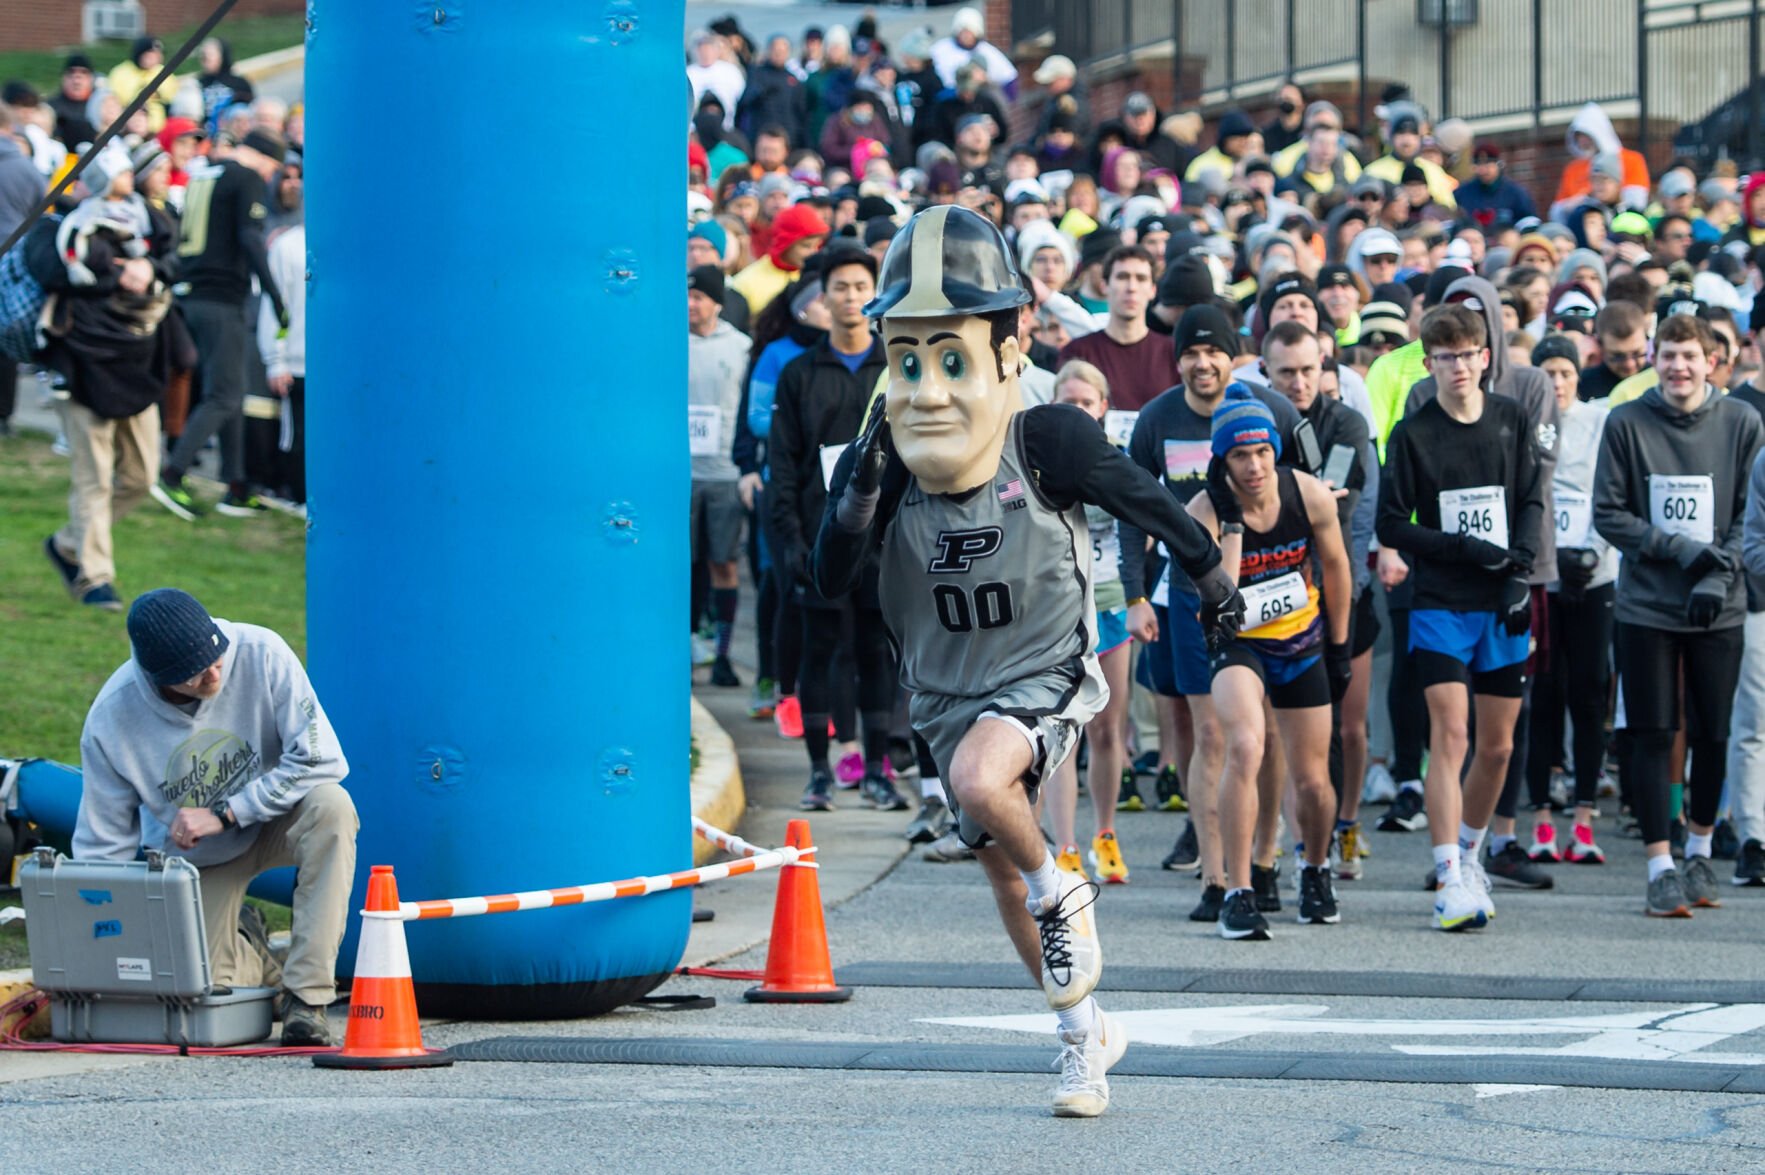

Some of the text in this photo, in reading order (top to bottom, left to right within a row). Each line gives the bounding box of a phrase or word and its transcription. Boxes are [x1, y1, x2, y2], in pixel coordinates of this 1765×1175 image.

[1457, 508, 1493, 534] 846
[1663, 496, 1697, 520] 602
[927, 526, 1004, 574] P
[932, 581, 1015, 633] 00
[1260, 595, 1294, 622] 695
[157, 754, 210, 804] Tuxedo
